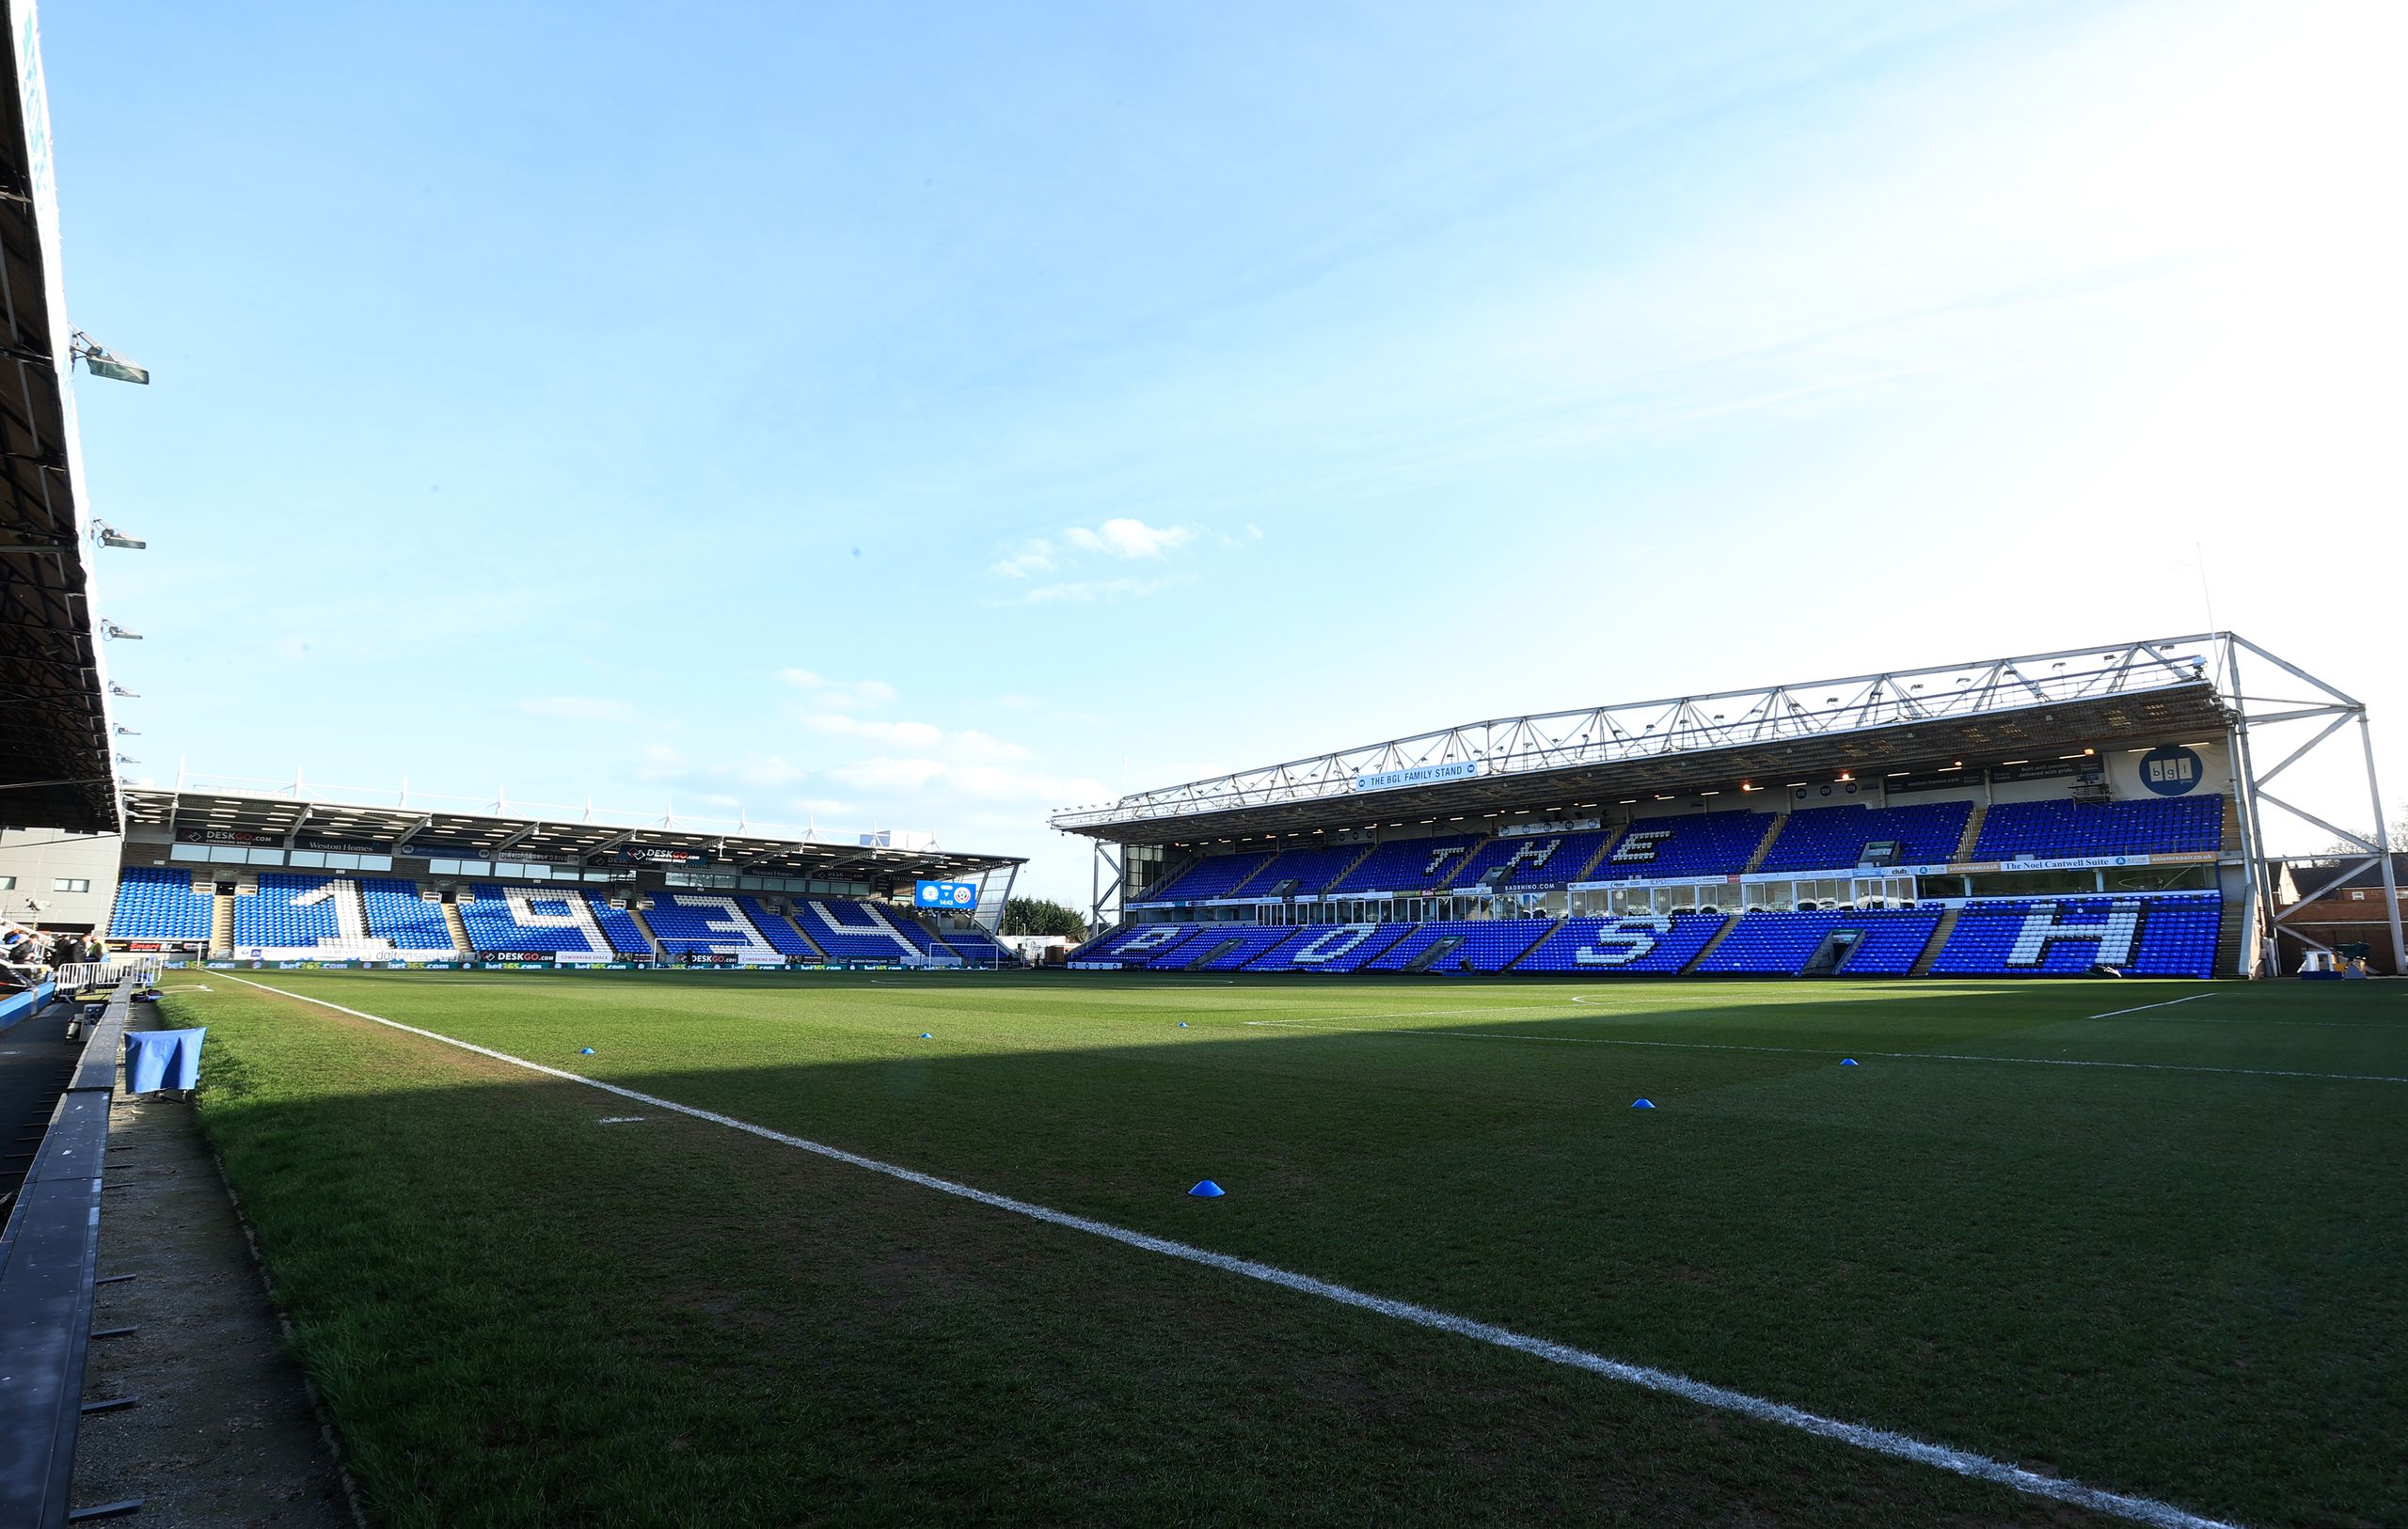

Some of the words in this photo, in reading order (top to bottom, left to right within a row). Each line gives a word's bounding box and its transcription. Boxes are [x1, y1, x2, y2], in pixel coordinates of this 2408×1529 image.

[1370, 776, 1385, 786] THE
[1386, 774, 1402, 784] BGL
[1404, 769, 1433, 781] FAMILY
[1434, 765, 1463, 778] STAND
[206, 830, 272, 842] DESKGO.COM
[309, 842, 342, 851] Weston
[342, 843, 374, 853] Homes
[646, 848, 701, 860] DESKGO.COM
[2151, 853, 2213, 863] axiomrepair.co.uk
[2044, 859, 2083, 868] Cantwell
[2085, 858, 2109, 866] Suite
[1504, 883, 1555, 891] BADRHINO.COM
[498, 953, 554, 961] DESKGO.COM
[279, 961, 348, 969] bet365.com
